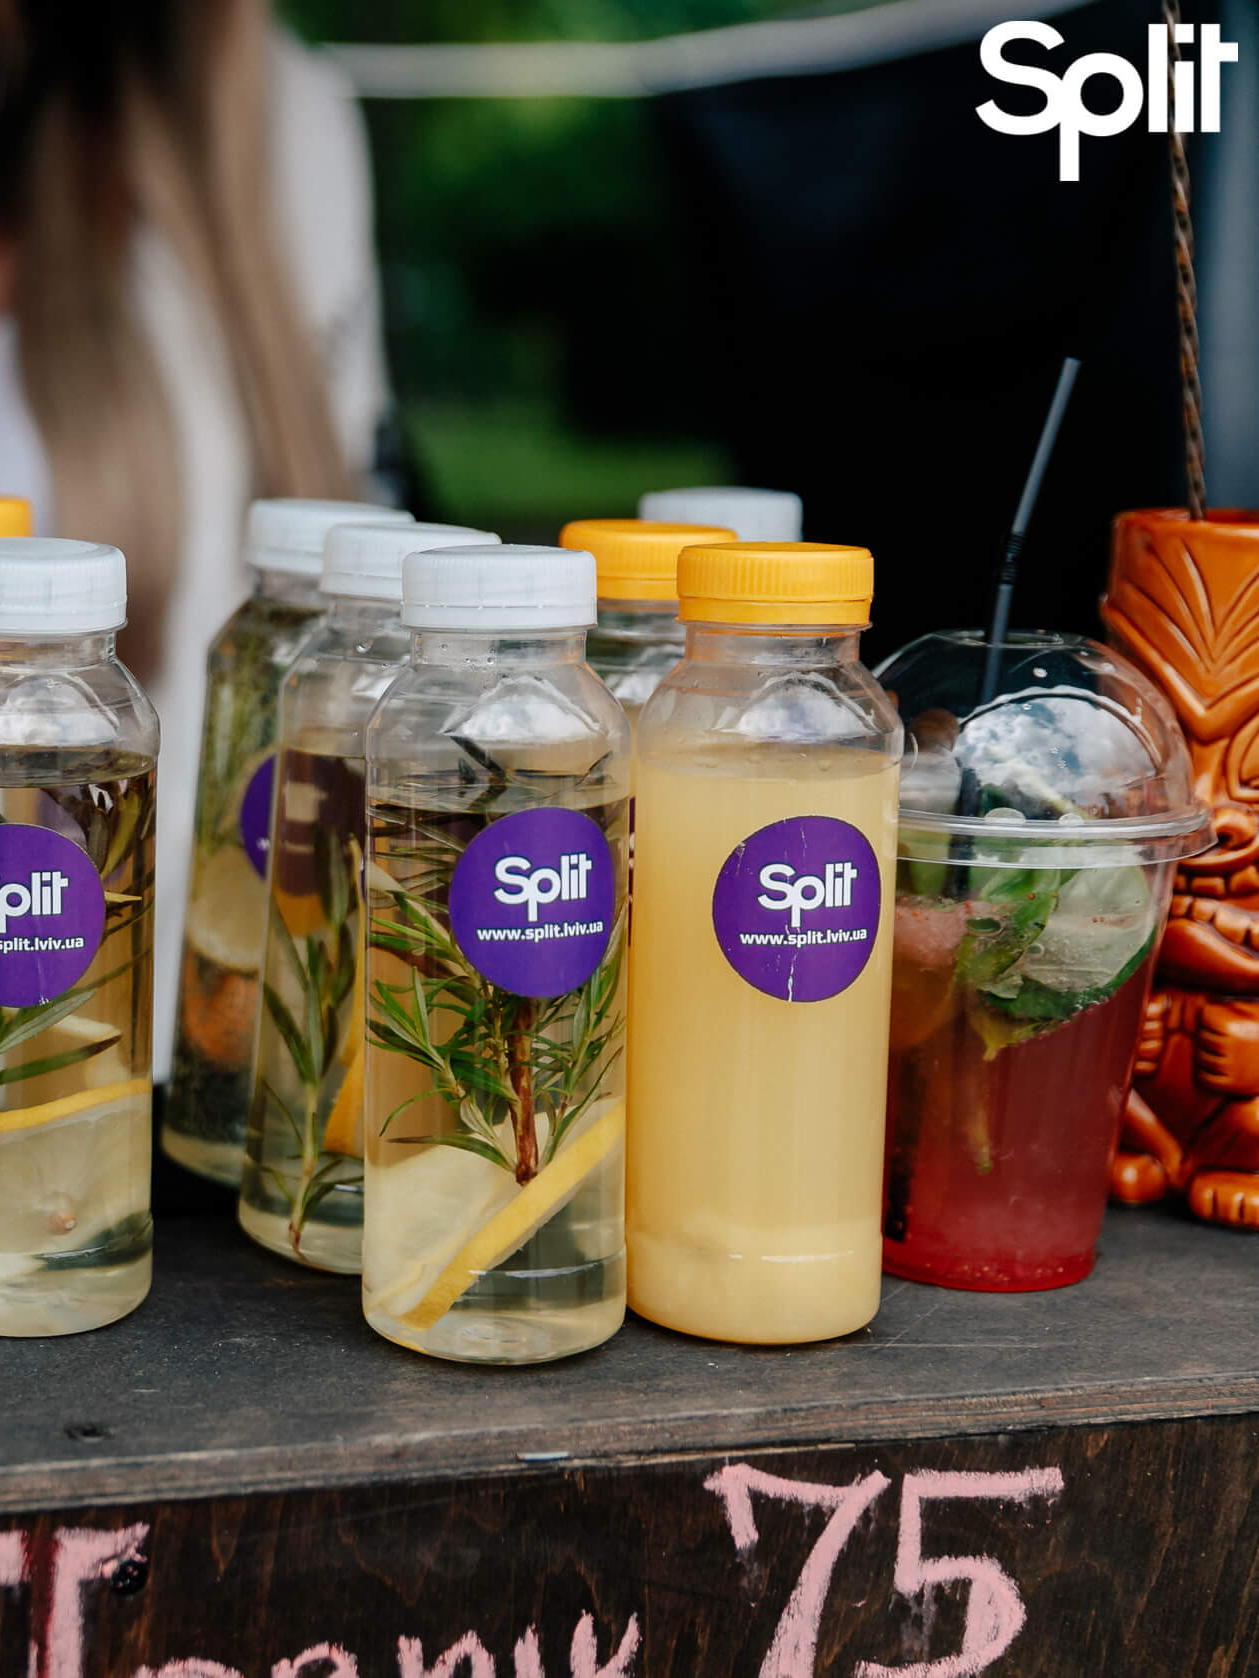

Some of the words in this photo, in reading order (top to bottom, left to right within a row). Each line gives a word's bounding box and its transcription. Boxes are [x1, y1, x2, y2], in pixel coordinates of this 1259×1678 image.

[493, 853, 593, 922] Split
[757, 861, 858, 928] Split
[476, 920, 604, 943] www.split.lviv.ua
[739, 928, 868, 949] www.split.lviv.ua
[703, 1463, 1065, 1678] 75
